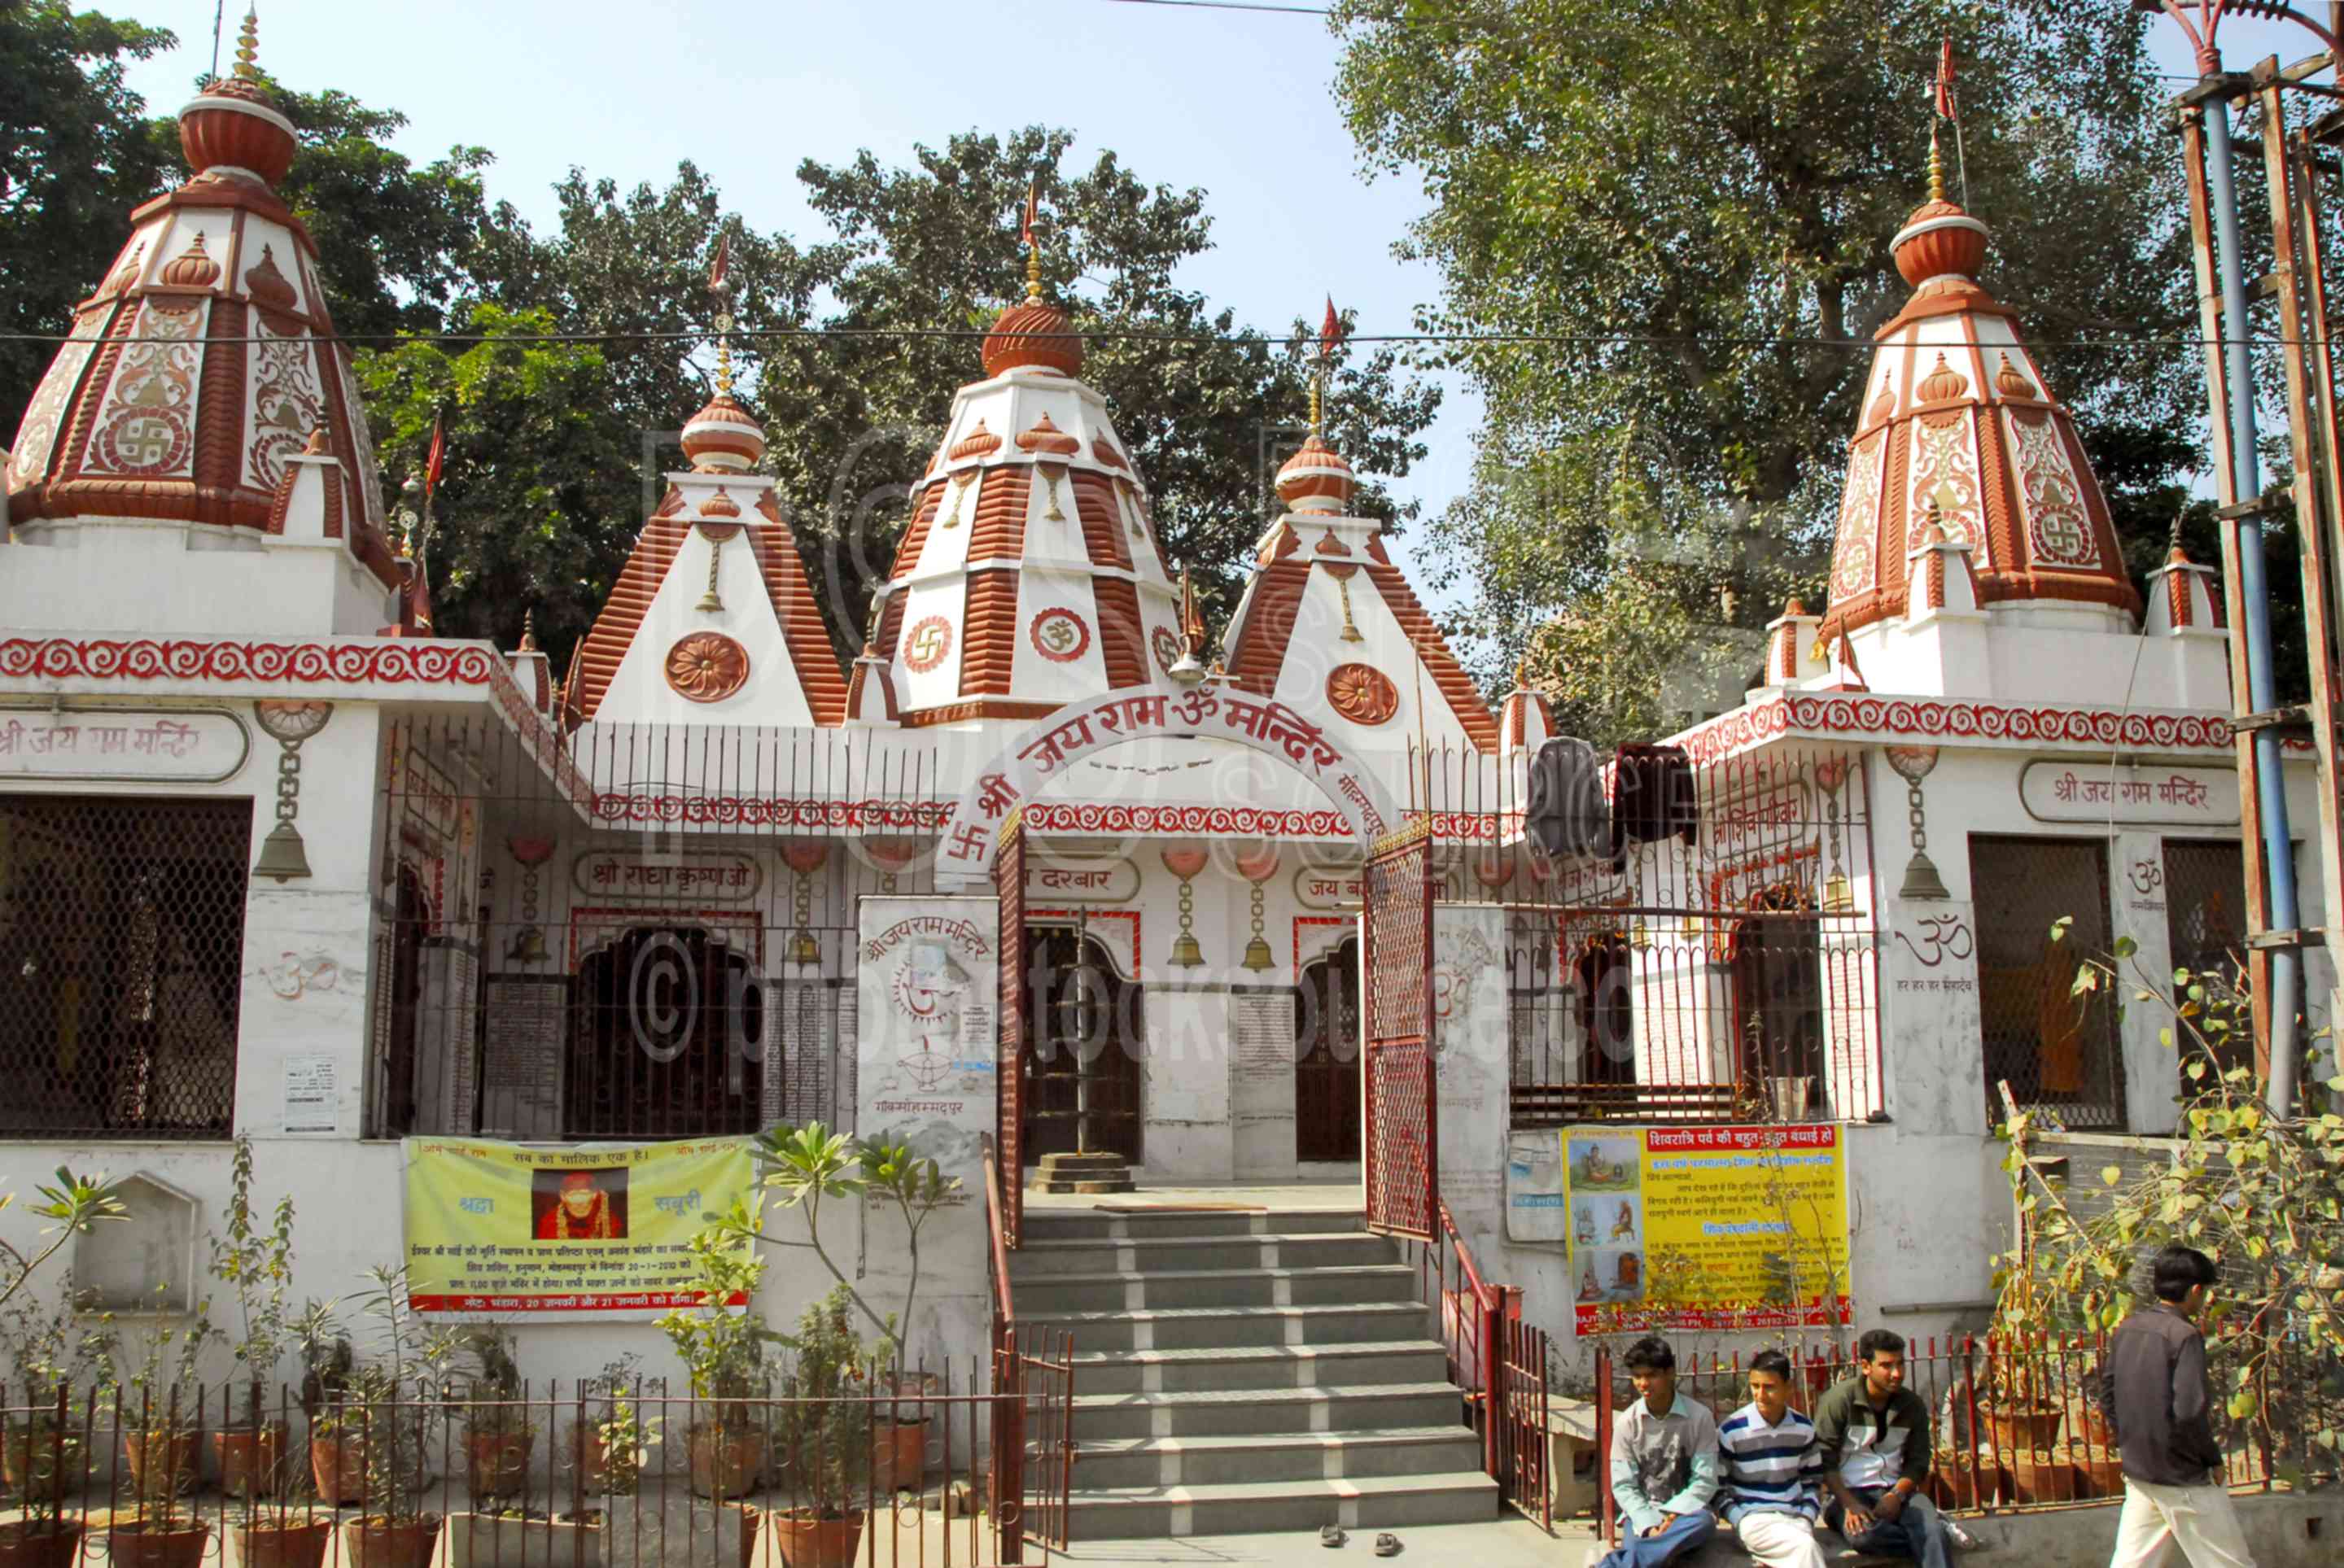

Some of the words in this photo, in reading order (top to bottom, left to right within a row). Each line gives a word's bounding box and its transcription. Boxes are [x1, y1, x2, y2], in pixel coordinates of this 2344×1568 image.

[29, 726, 80, 754] जय
[976, 772, 1022, 821] श्री
[1017, 713, 1099, 775] जय
[1093, 693, 1170, 737] राम
[1222, 697, 1345, 777] मन्दिर
[2054, 771, 2079, 802] श्री
[2081, 780, 2116, 804] जय
[2121, 781, 2153, 804] राम
[2157, 774, 2209, 809] मन्दिर
[593, 858, 620, 884] श्री
[1039, 868, 1112, 891] दरबार
[1309, 878, 1340, 897] जय
[867, 937, 887, 962] श्री
[879, 920, 912, 946] जय
[910, 916, 944, 935] राम
[1650, 1128, 1695, 1147] शिवरात्रि
[514, 1152, 531, 1164] सब
[539, 1152, 554, 1164] का
[561, 1151, 600, 1164] मालिक
[608, 1151, 627, 1164] एक
[526, 1298, 539, 1308] 20
